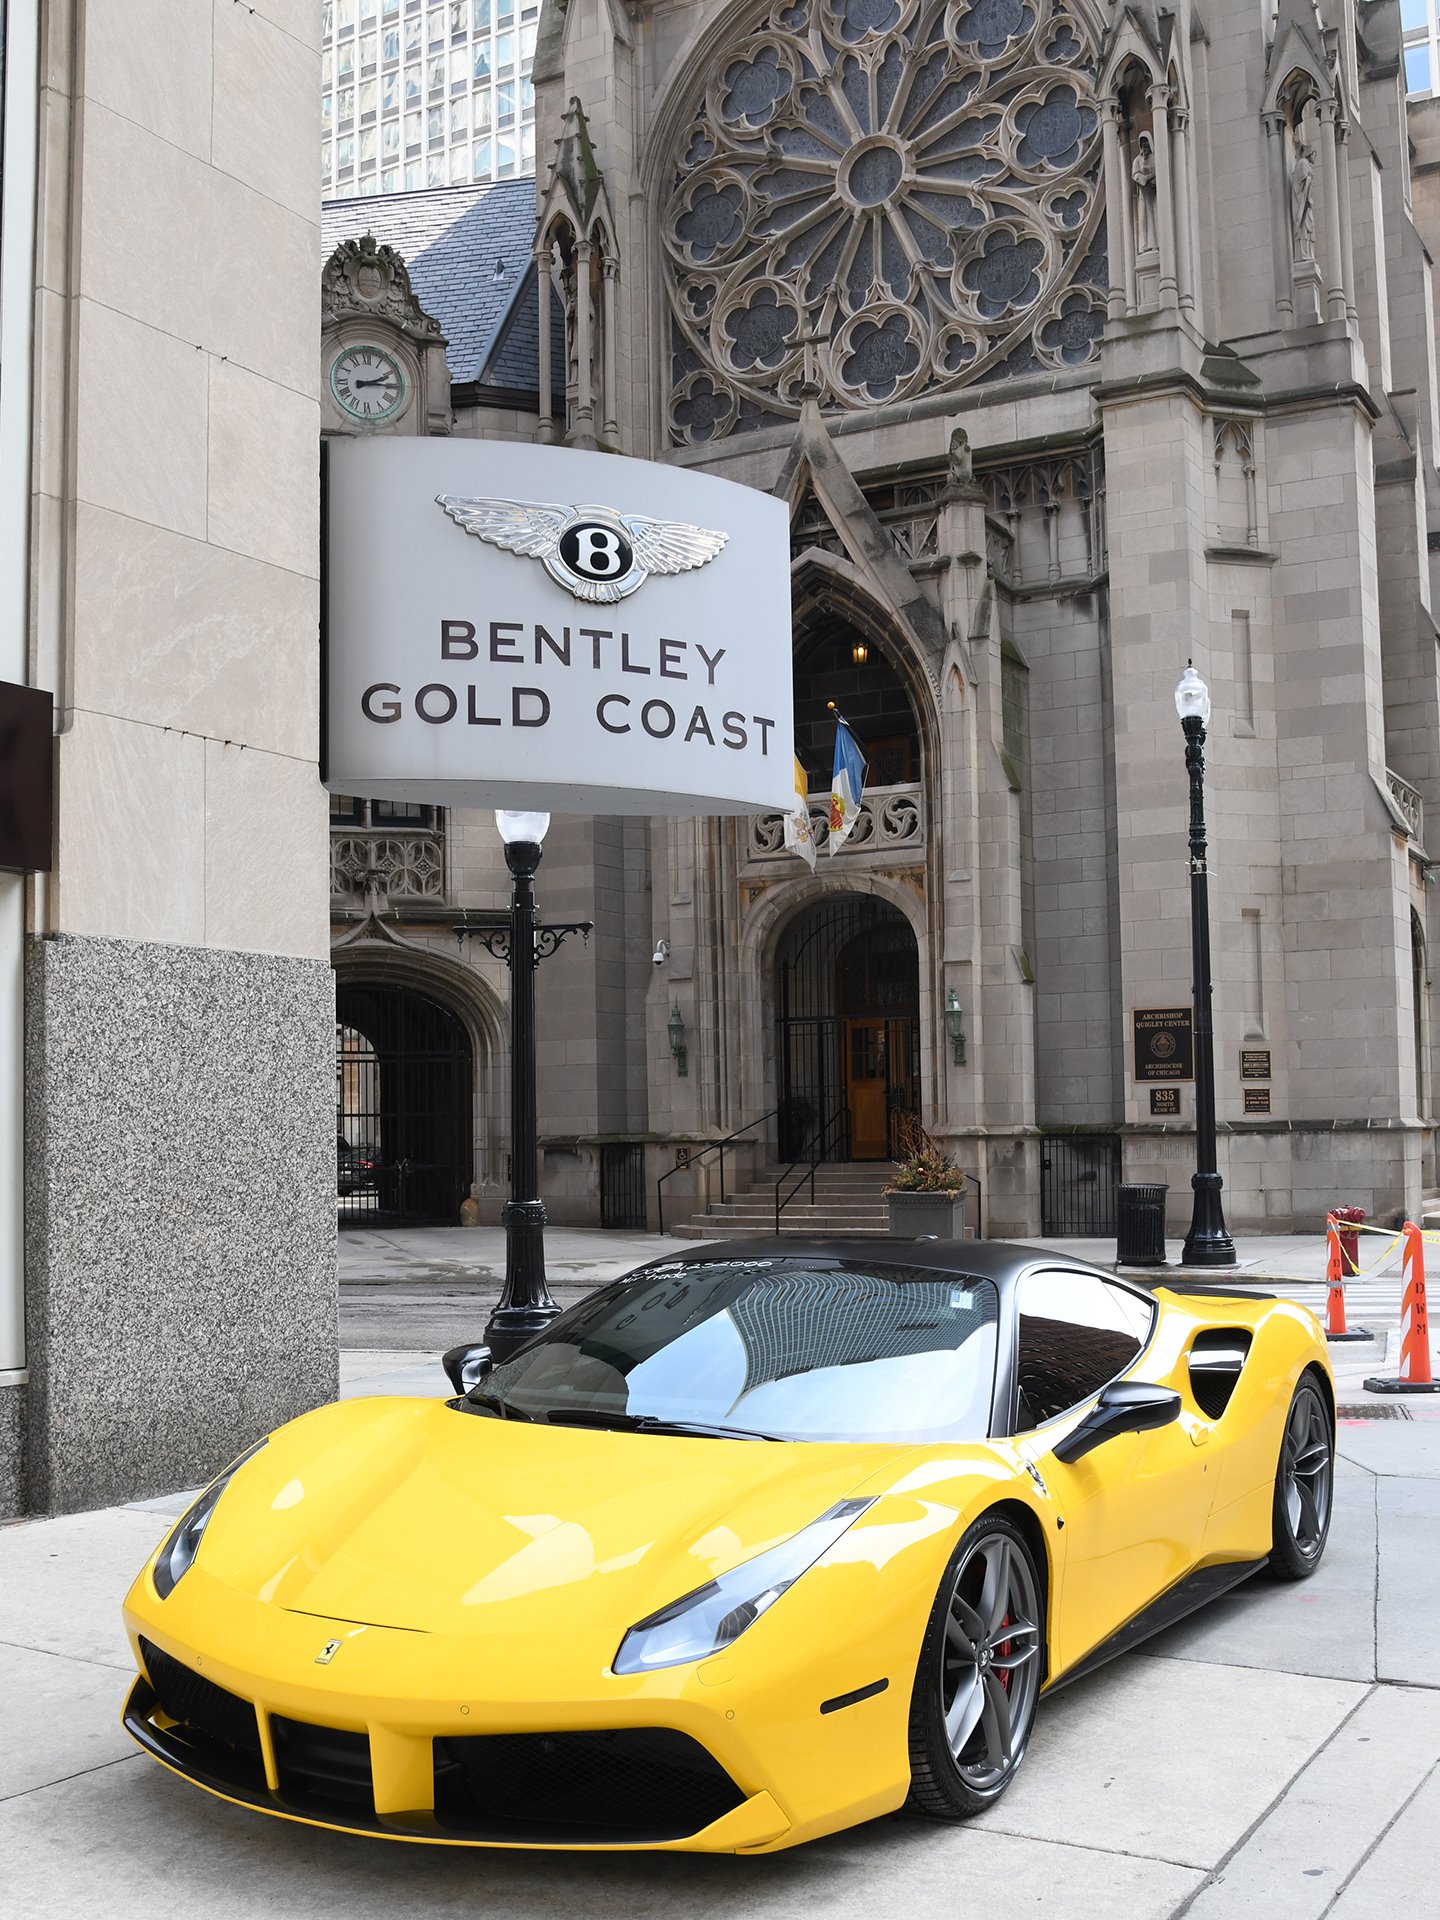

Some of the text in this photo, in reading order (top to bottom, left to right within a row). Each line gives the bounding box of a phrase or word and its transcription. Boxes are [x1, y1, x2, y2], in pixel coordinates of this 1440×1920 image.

[575, 527, 621, 576] B
[440, 620, 727, 685] BENTLEY
[361, 682, 776, 756] GOLD COAST
[1135, 1021, 1163, 1029] QUIGLEY
[1142, 1012, 1184, 1020] ARCHBISHOP
[1155, 1090, 1175, 1102] 835
